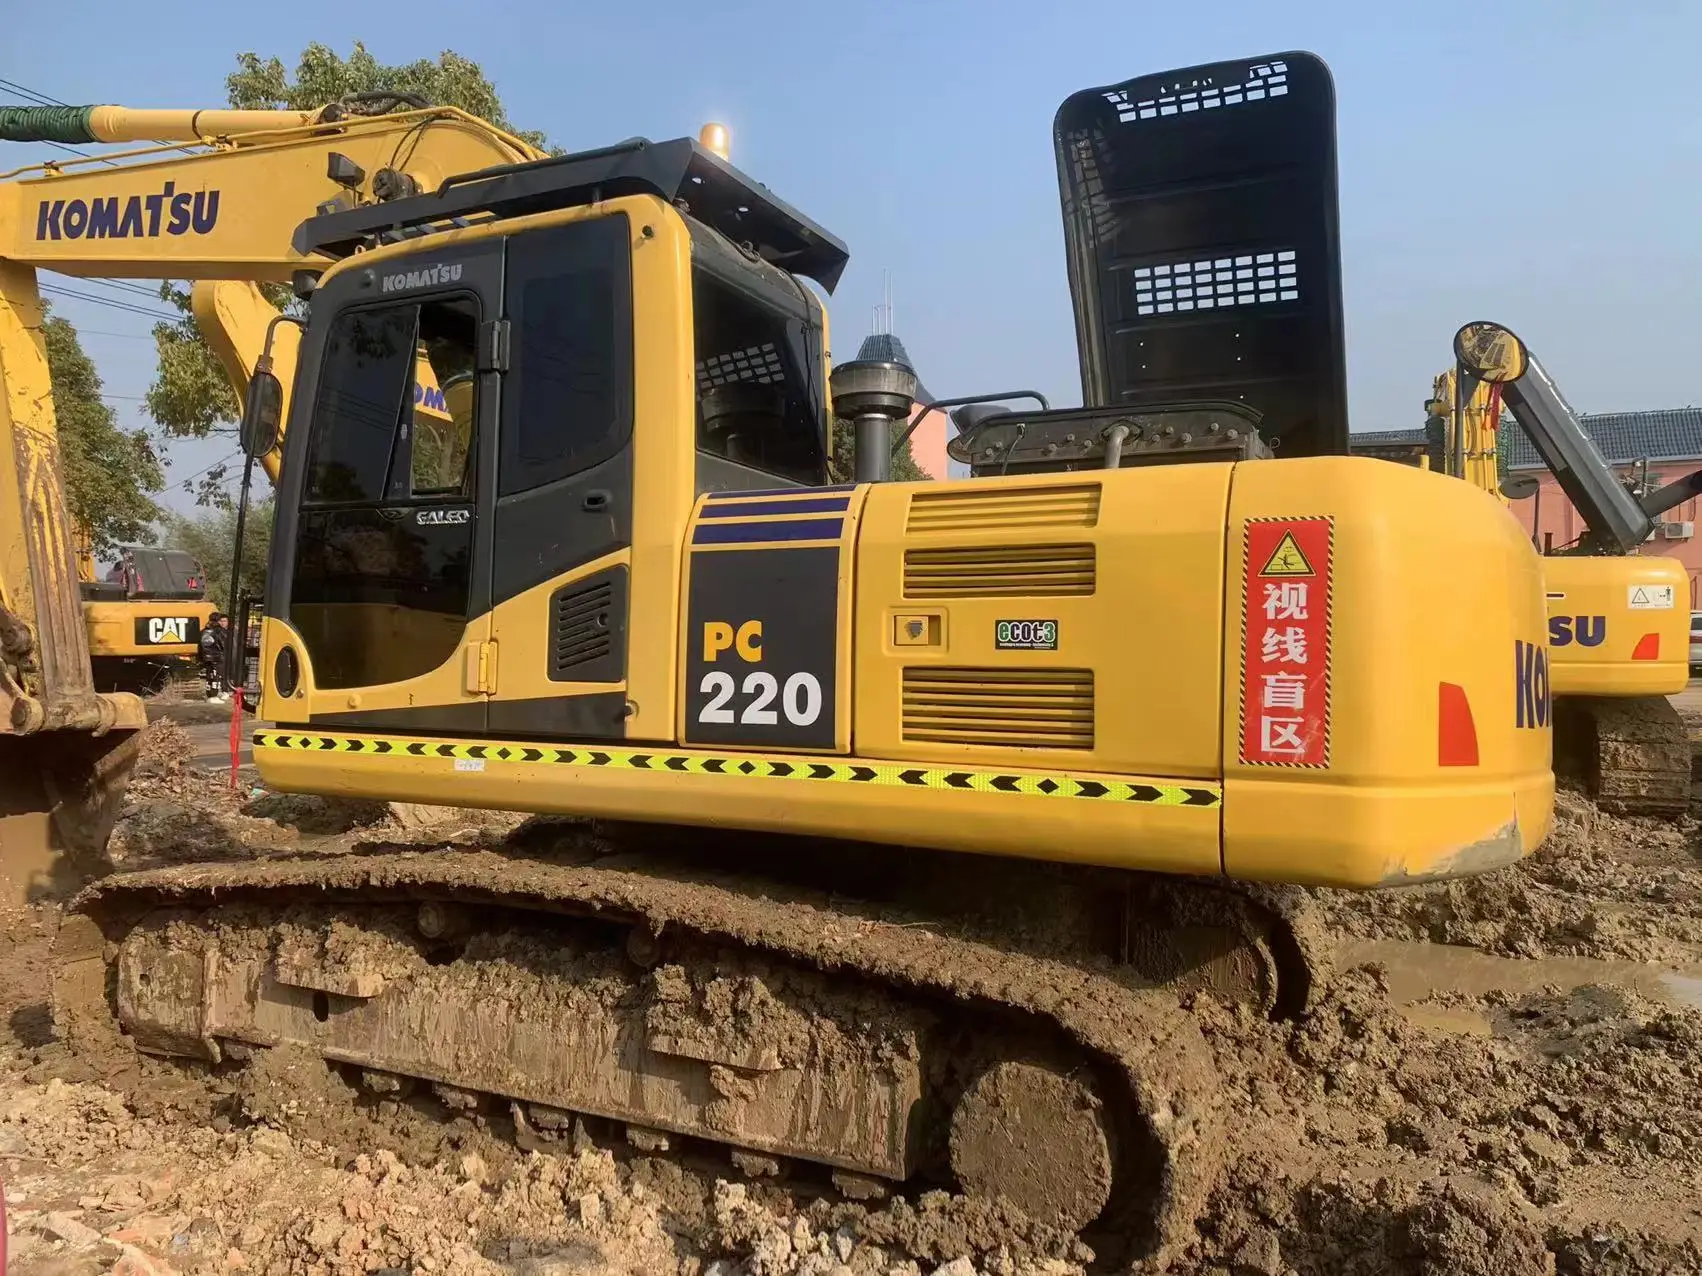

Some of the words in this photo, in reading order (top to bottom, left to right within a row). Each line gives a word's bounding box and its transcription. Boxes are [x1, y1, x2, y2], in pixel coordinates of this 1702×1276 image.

[36, 181, 220, 240] KOMATSU
[382, 263, 462, 293] KOMATSU
[148, 617, 188, 643] CAT
[703, 620, 762, 662] PC
[997, 621, 1056, 643] ecot3
[1547, 615, 1606, 647] SU
[1260, 582, 1309, 755] 视线盲区
[1515, 639, 1549, 729] KO
[698, 671, 822, 726] 220
